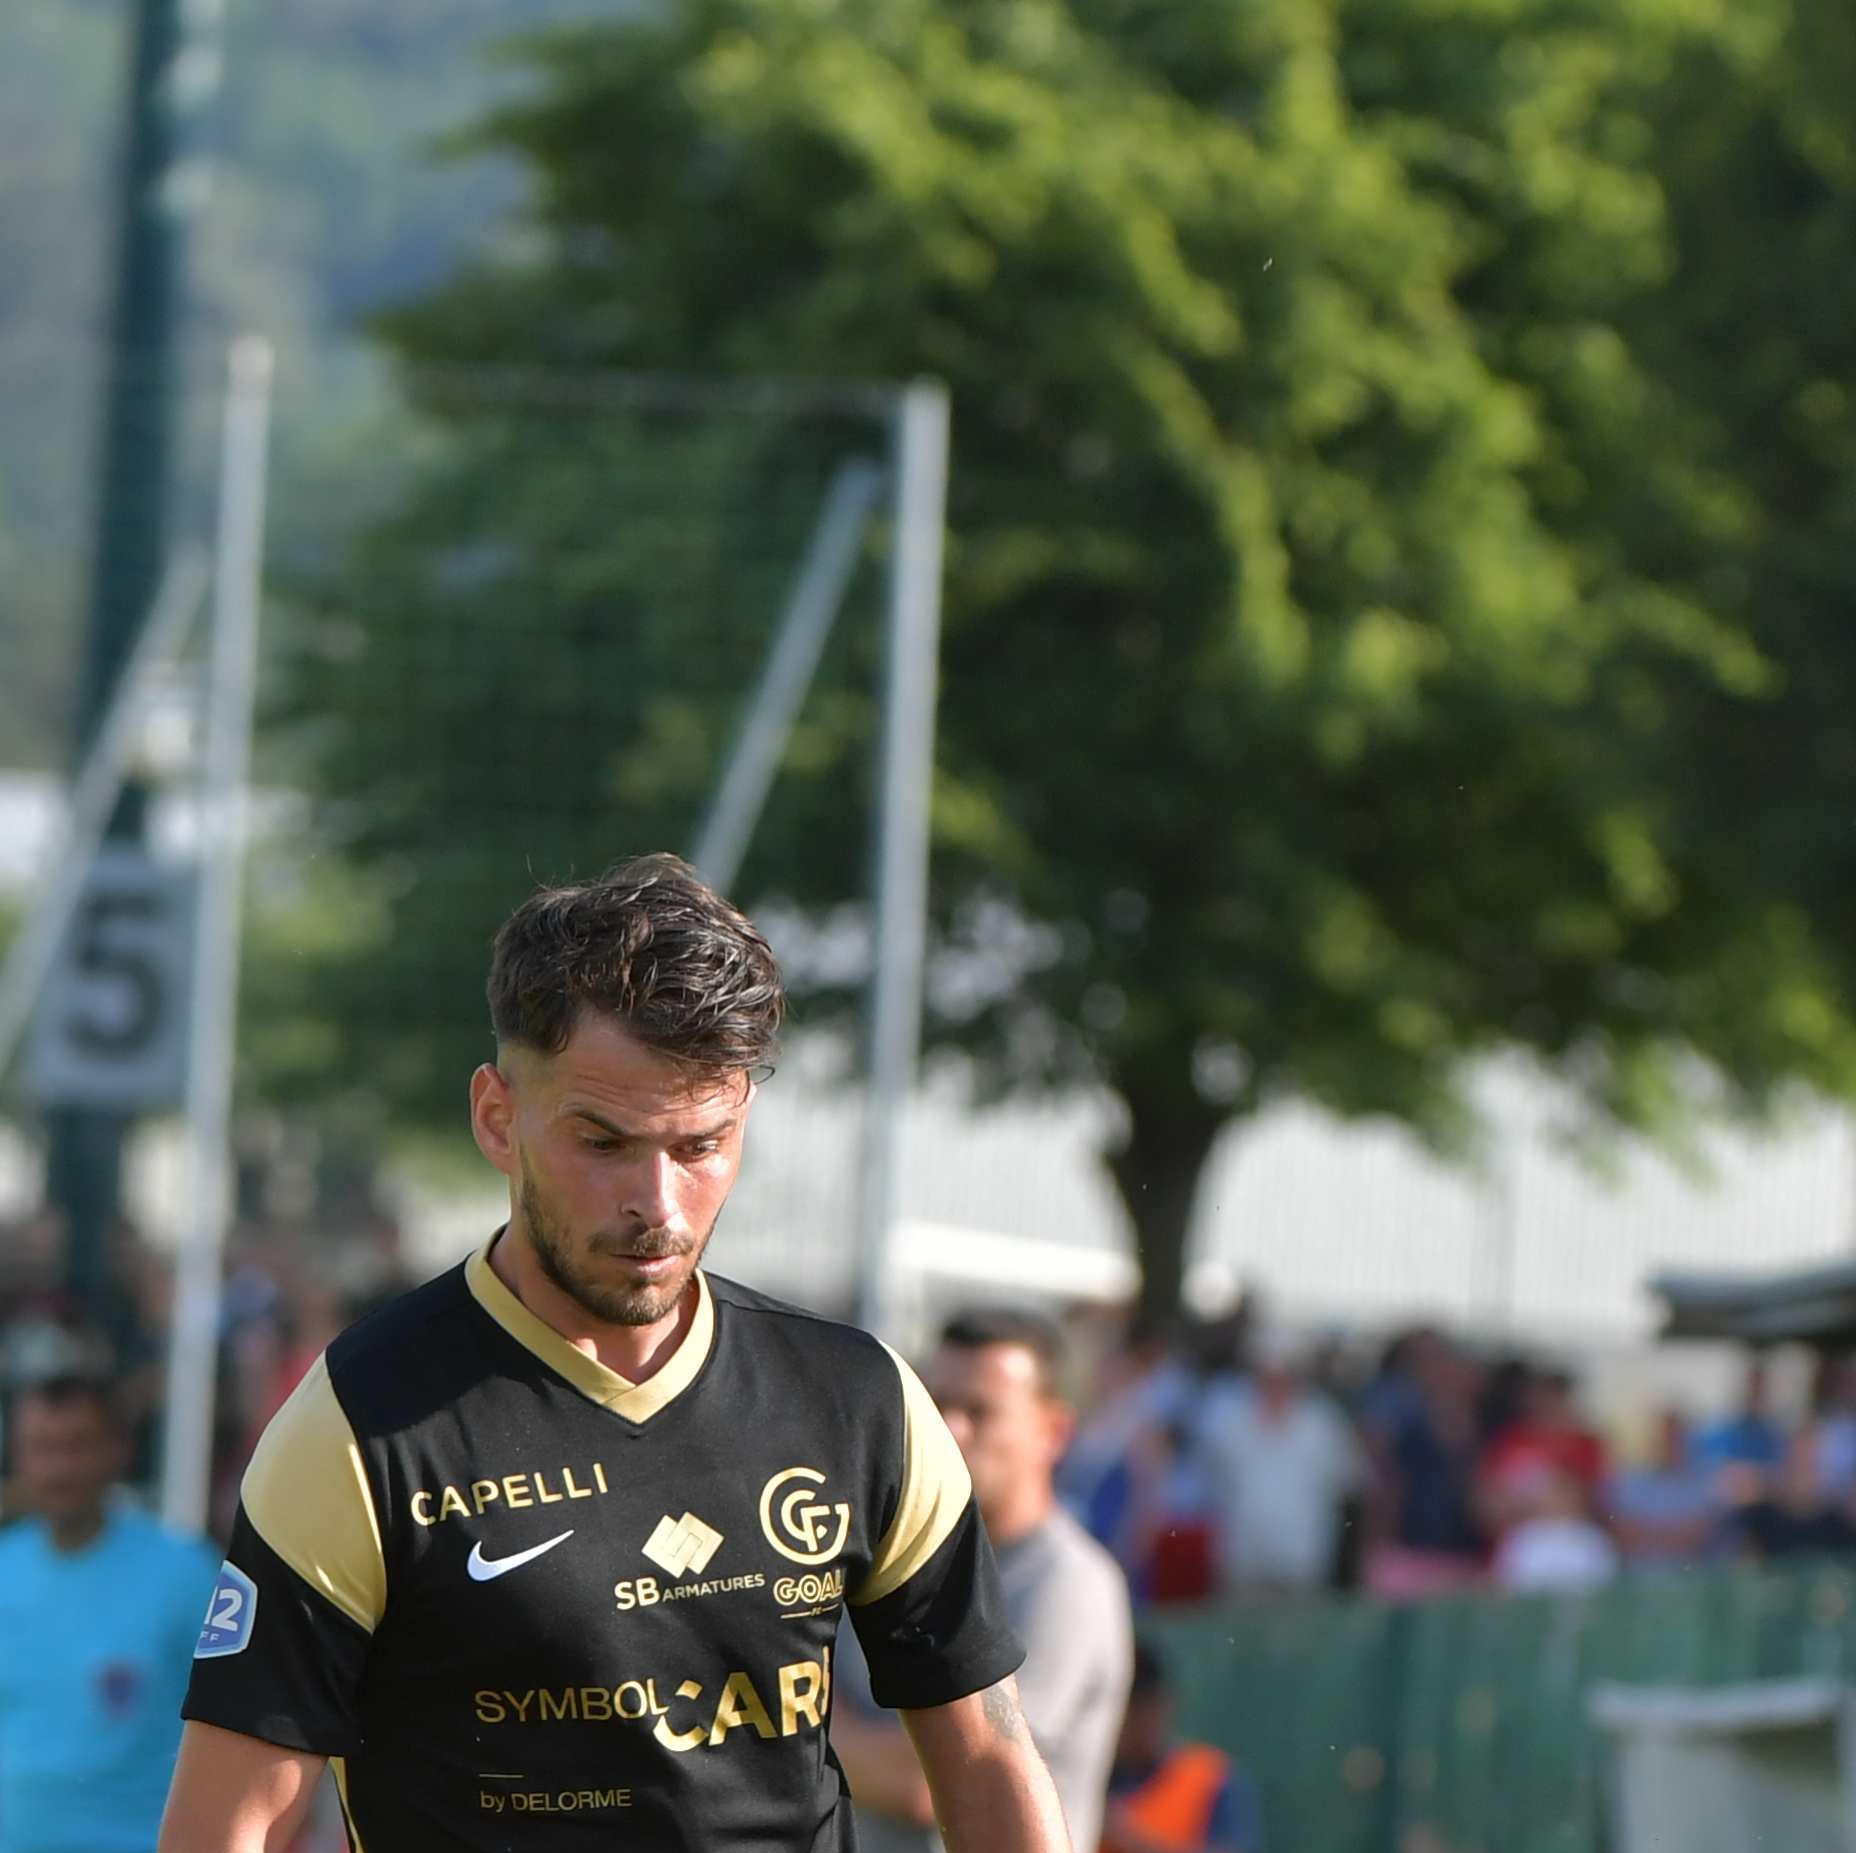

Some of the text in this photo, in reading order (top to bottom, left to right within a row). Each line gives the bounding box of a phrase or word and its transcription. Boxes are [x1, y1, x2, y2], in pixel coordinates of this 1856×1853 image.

[62, 890, 166, 1062] 5
[410, 1463, 609, 1527] CAPELLI
[614, 1573, 766, 1611] SB ARMATURES
[772, 1568, 843, 1606] GOAL
[652, 1646, 829, 1752] CAR
[480, 1789, 633, 1813] by DELORME
